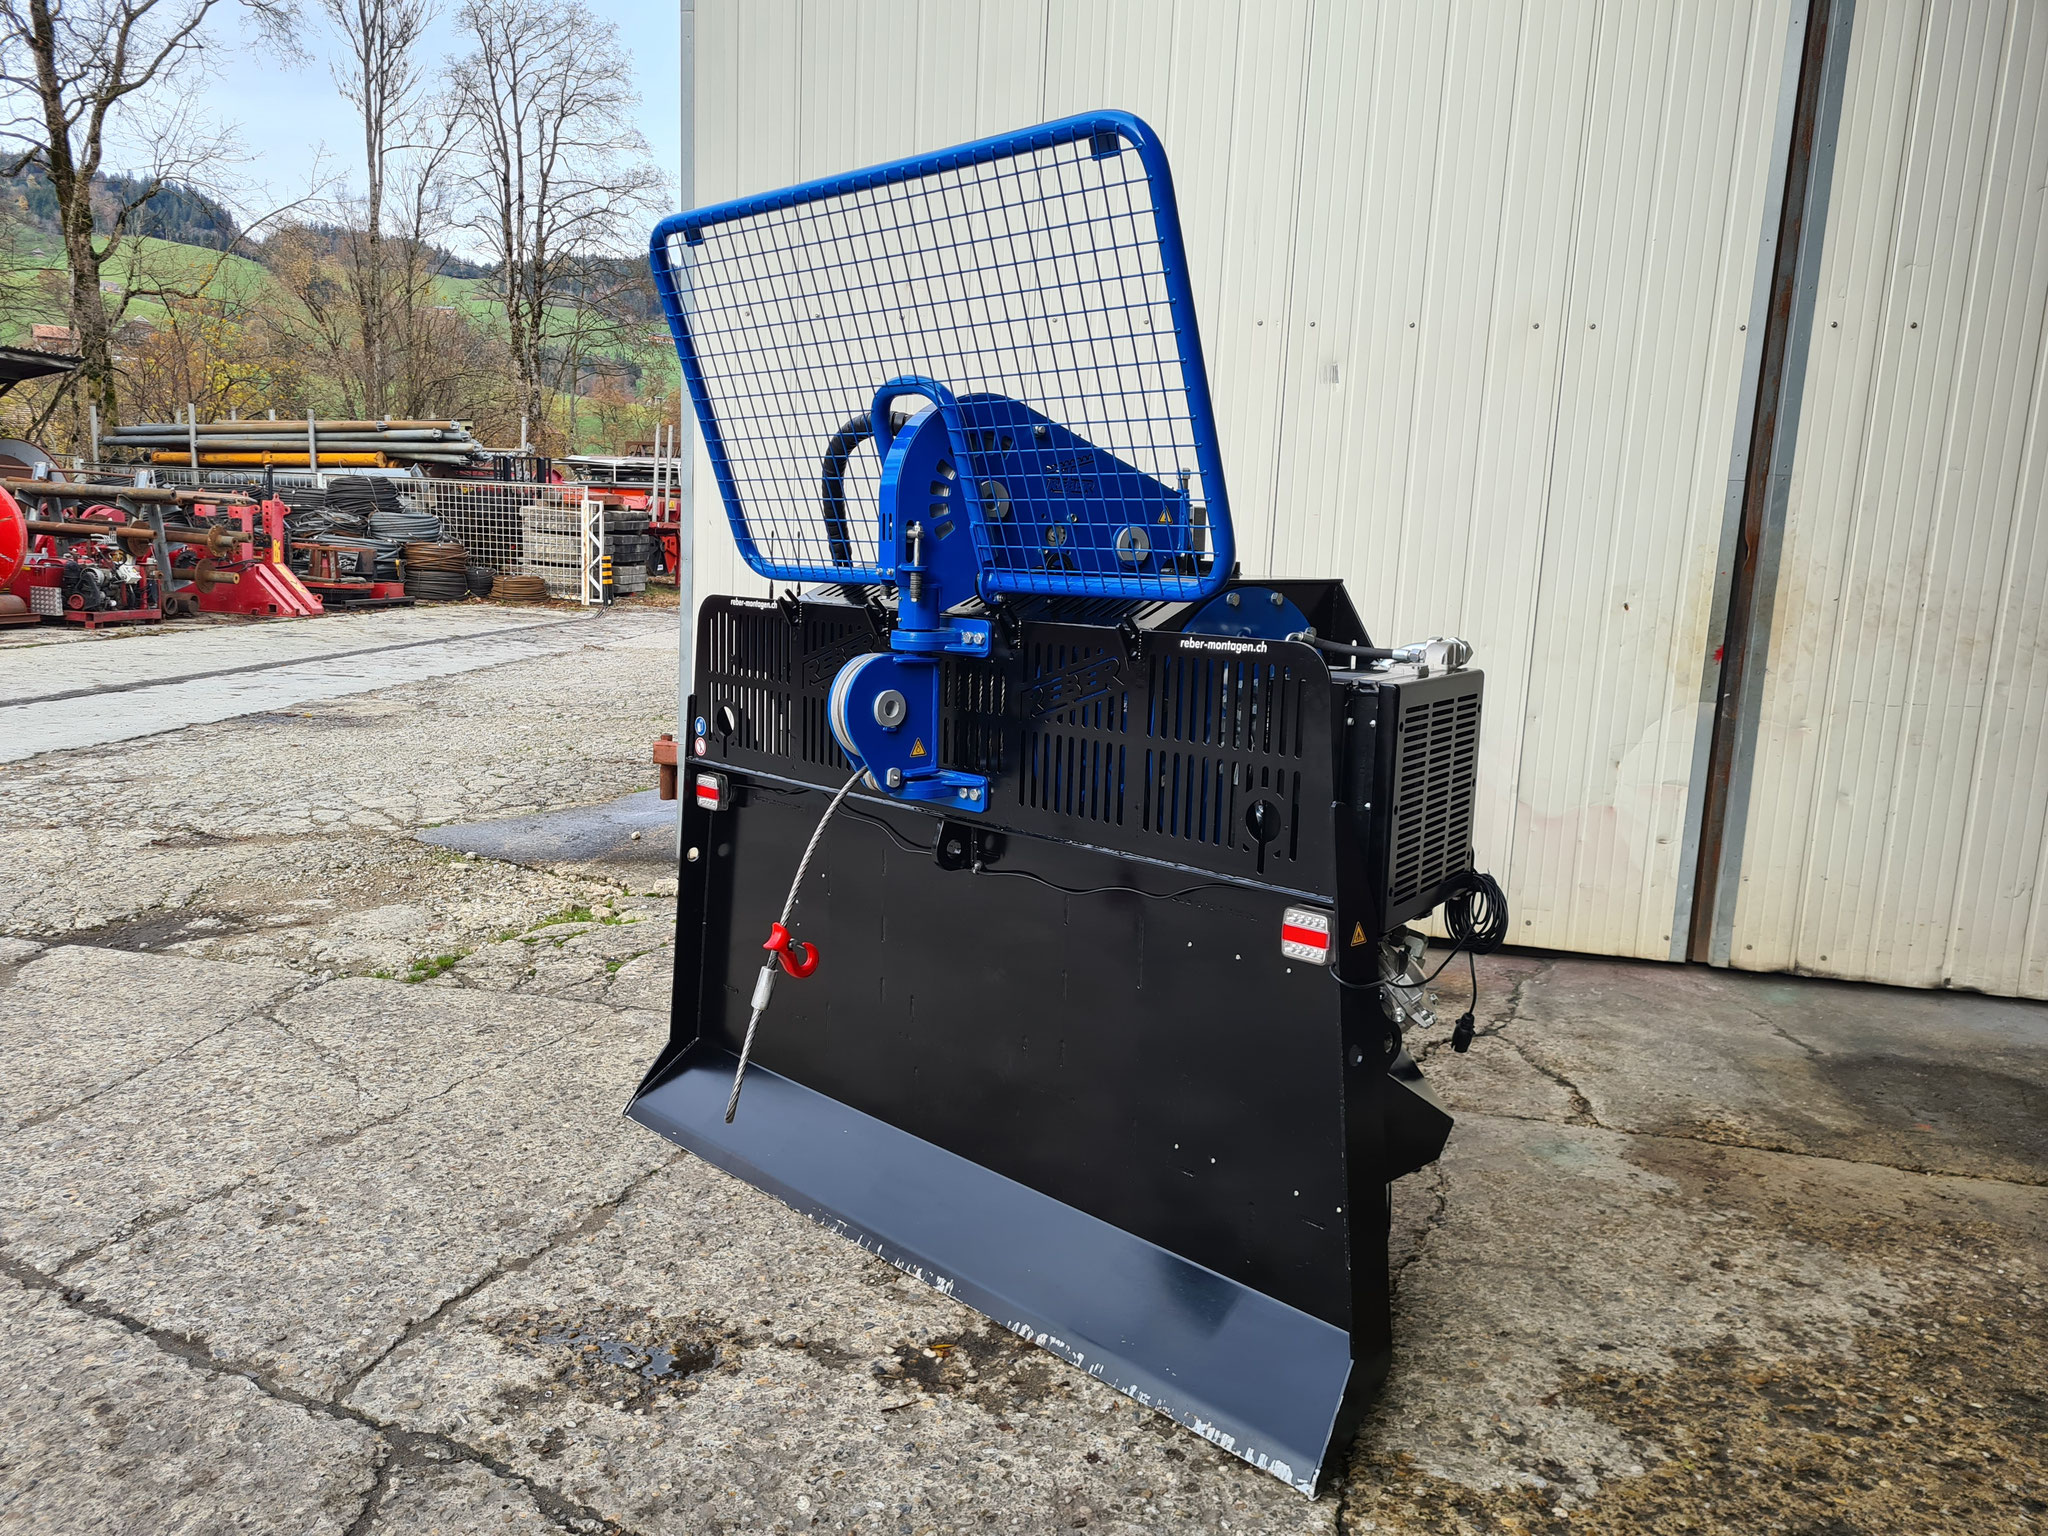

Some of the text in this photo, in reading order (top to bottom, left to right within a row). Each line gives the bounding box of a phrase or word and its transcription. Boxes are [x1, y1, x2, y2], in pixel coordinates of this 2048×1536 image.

[730, 597, 778, 610] reber-montagen.ch
[1180, 637, 1268, 653] reber-montagen.ch
[1020, 656, 1125, 722] REBER
